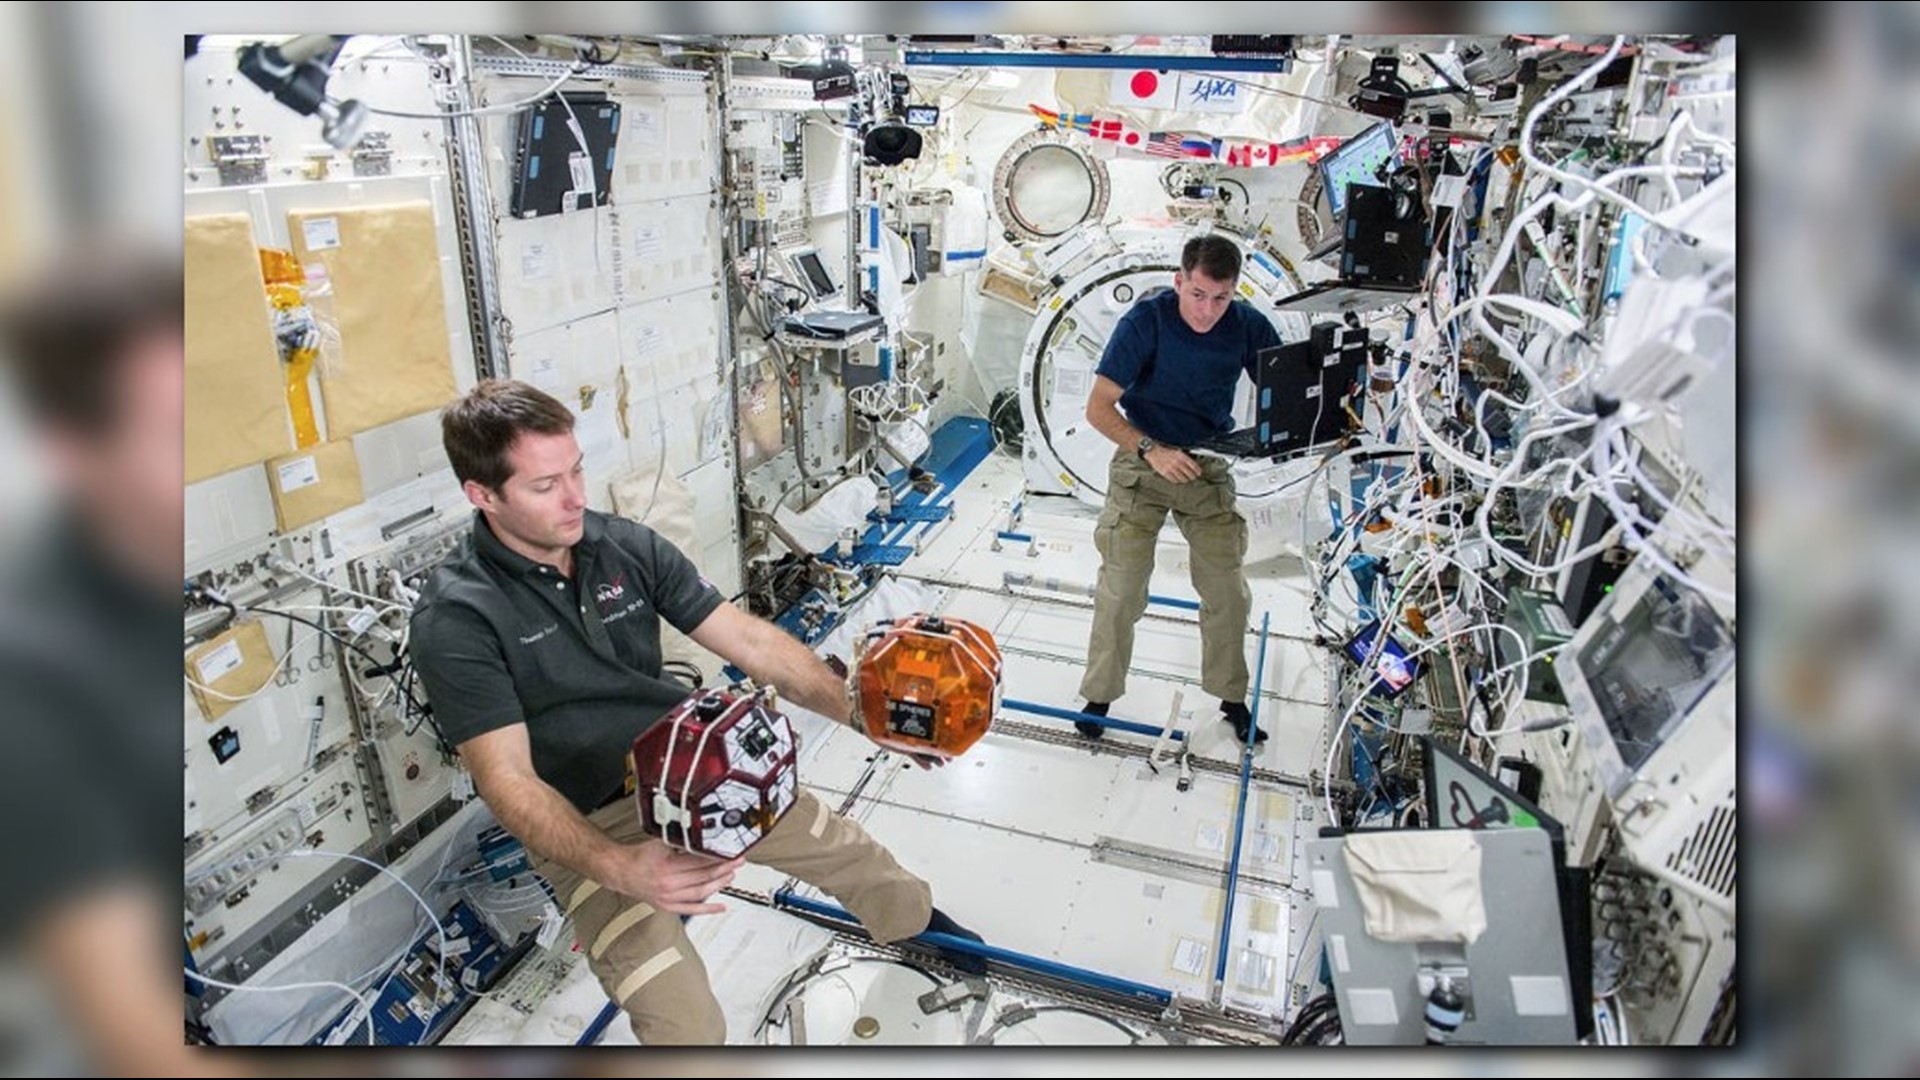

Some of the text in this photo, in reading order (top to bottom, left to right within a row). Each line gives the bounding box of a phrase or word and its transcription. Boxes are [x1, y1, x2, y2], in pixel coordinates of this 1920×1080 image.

[1190, 79, 1237, 103] JAXA
[598, 584, 624, 602] NASA
[899, 703, 932, 718] SPHERES
